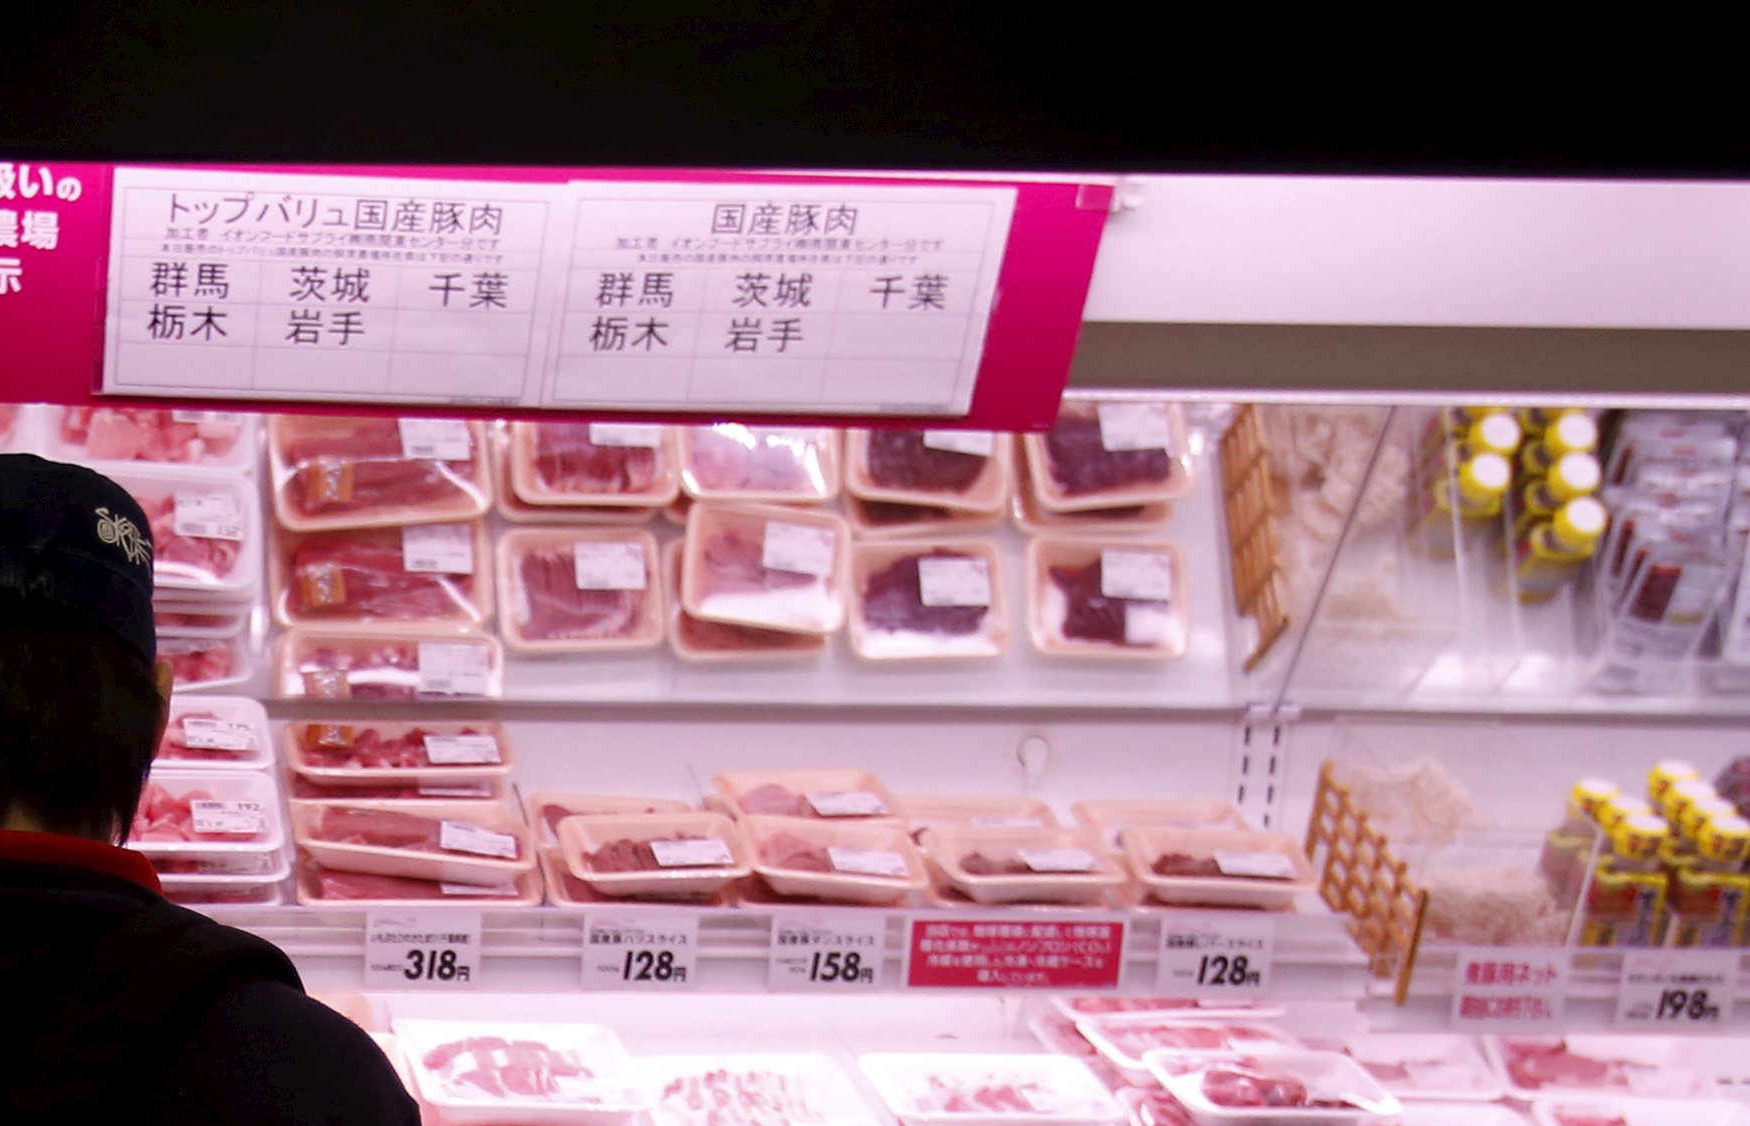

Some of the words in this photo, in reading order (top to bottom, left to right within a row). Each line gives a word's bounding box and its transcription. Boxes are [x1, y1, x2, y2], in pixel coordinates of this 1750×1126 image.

[167, 192, 503, 235] トップバリュ国産豚肉
[710, 203, 858, 236] 国産豚肉
[149, 262, 229, 300] 群馬
[289, 267, 370, 303] 茨城
[428, 272, 509, 308] 千葉
[595, 272, 673, 308] 群馬
[731, 273, 812, 309] 茨城
[870, 275, 948, 310] 千葉
[147, 303, 228, 341] 栃木
[285, 310, 366, 345] 岩手
[588, 316, 670, 352] 栃木
[724, 318, 802, 353] 岩手
[403, 949, 469, 983] 318円
[622, 950, 687, 983] 128円
[810, 951, 874, 984] 158円
[1197, 955, 1261, 986] 128円
